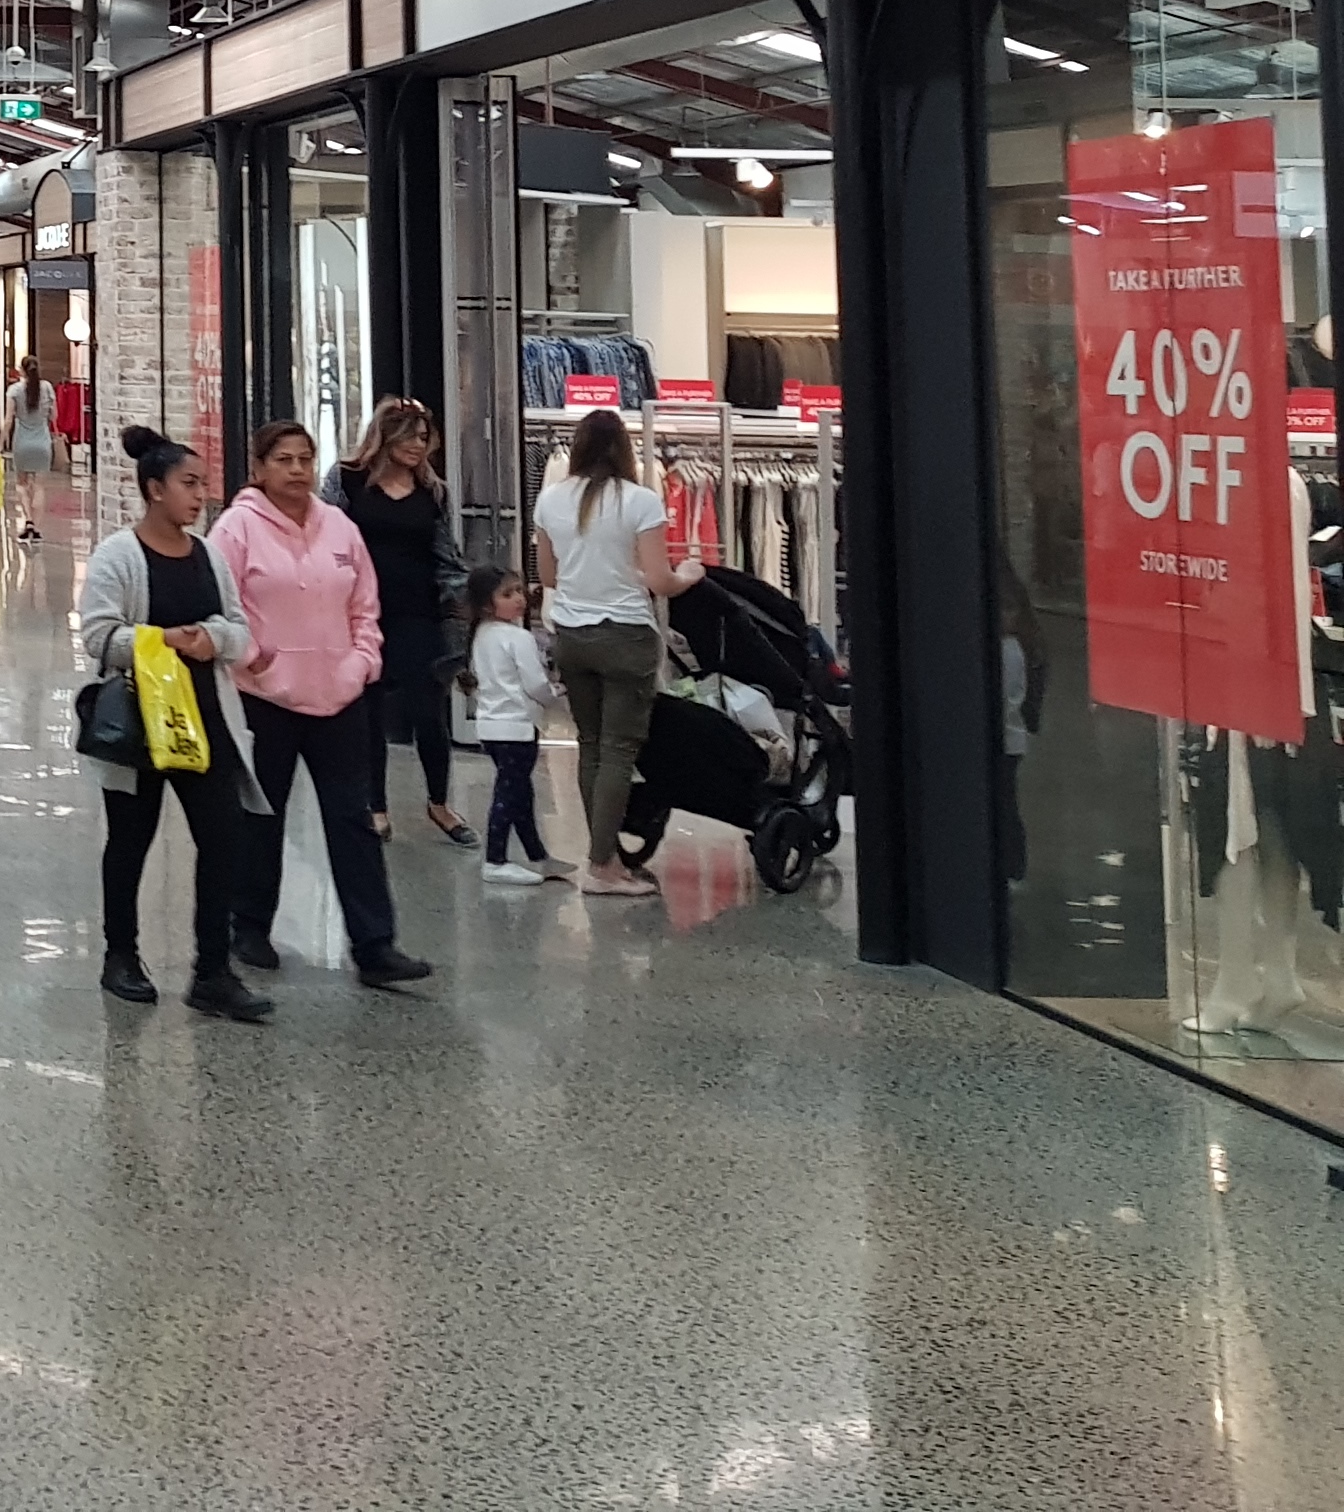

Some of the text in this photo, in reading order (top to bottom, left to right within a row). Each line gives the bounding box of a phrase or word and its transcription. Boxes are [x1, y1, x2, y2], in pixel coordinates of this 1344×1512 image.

[1108, 265, 1245, 291] TAKE A FURTHER
[1106, 327, 1253, 420] 40%
[1303, 416, 1326, 426] OFF
[1119, 430, 1247, 525] OFF
[1140, 550, 1229, 582] STOREWIDE
